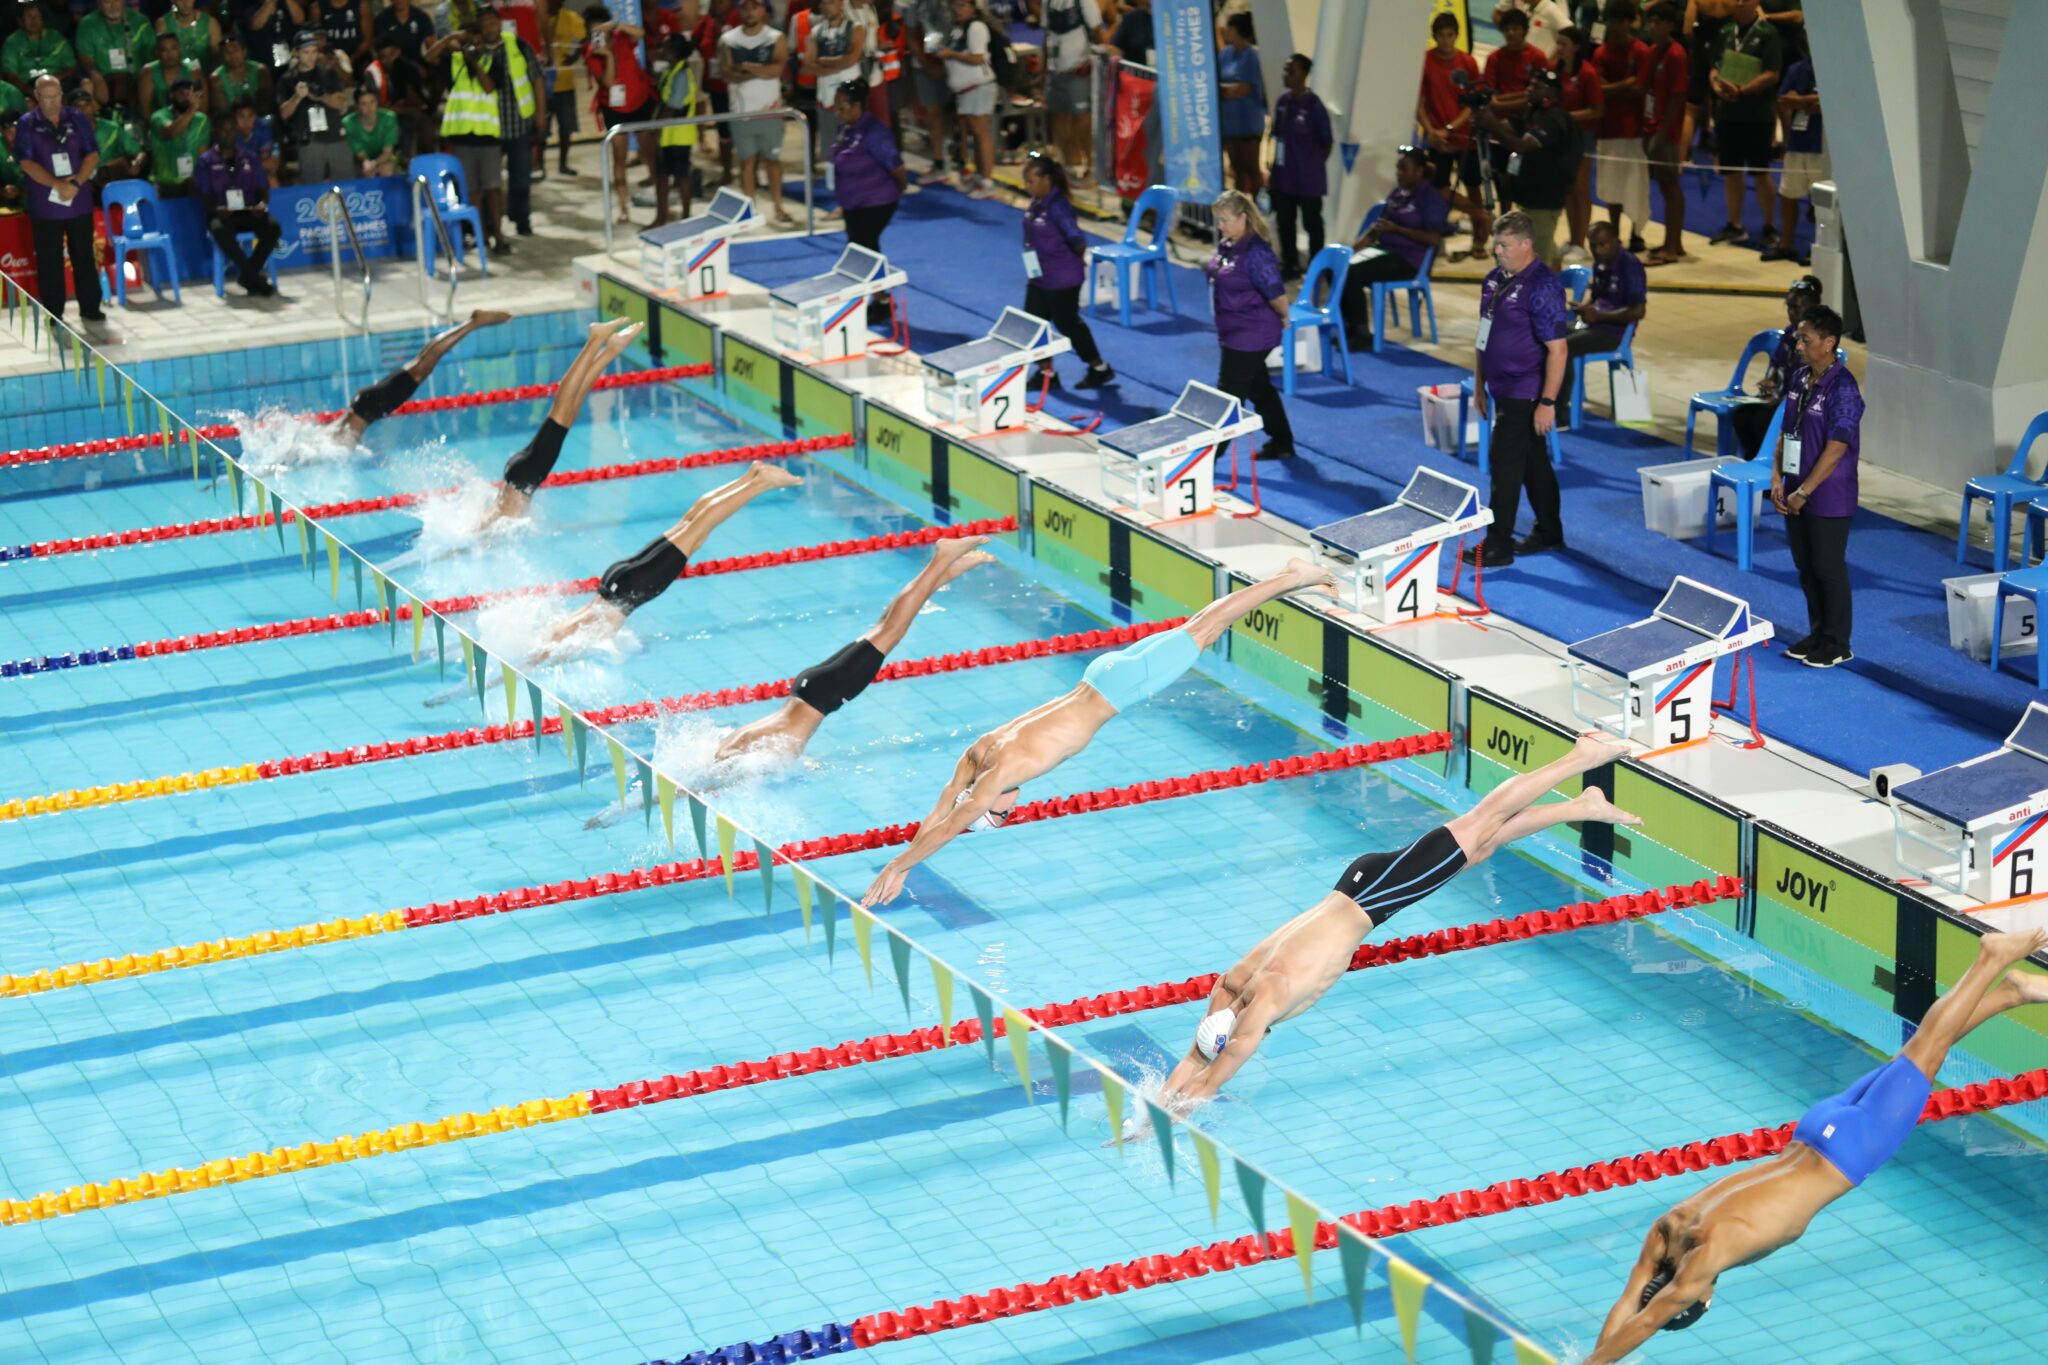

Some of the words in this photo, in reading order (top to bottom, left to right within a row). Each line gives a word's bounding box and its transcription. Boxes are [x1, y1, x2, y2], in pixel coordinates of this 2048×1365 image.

[841, 326, 848, 356] 1
[994, 396, 1010, 430] 2
[876, 426, 900, 454] JOYI
[1180, 478, 1196, 516] 3
[1044, 508, 1073, 539] JOYI
[1394, 541, 1413, 553] anti
[1397, 578, 1419, 619] 4
[1244, 609, 1279, 641] JOYI
[2020, 614, 2035, 637] 5
[1727, 640, 1743, 650] anti
[1665, 659, 1686, 672] anti
[1670, 697, 1691, 744] 5
[2008, 805, 2031, 822] anti
[2009, 848, 2034, 900] 6
